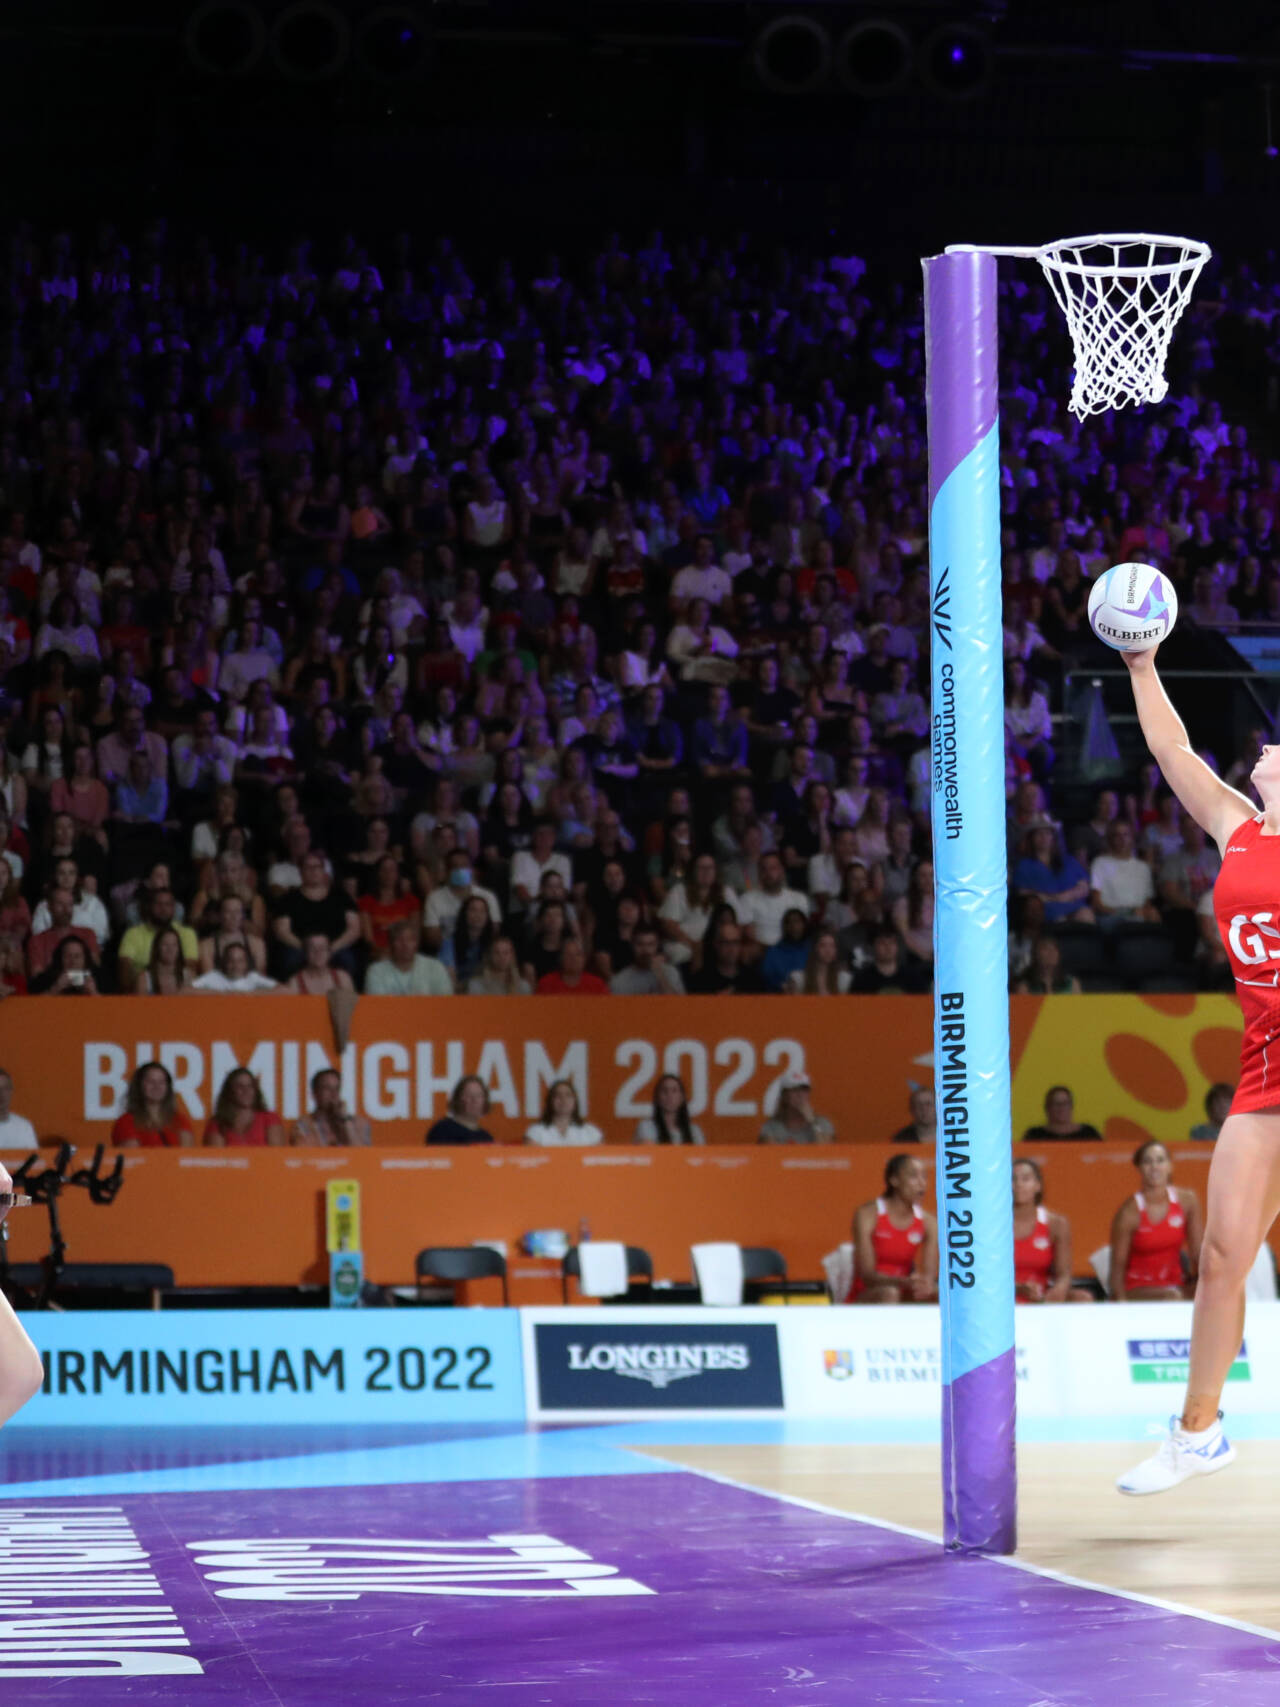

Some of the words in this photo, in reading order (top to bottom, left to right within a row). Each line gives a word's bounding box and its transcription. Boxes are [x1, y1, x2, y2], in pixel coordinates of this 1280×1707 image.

[1098, 622, 1161, 641] GILBERT
[932, 714, 943, 792] games
[941, 663, 962, 840] commonwealth
[941, 991, 972, 1200] BIRMINGHAM
[947, 1210, 976, 1291] 2022
[42, 1348, 346, 1395] IRMINGHAM
[364, 1346, 494, 1391] 2022
[568, 1345, 749, 1370] LONGINES
[185, 1534, 659, 1600] 2022
